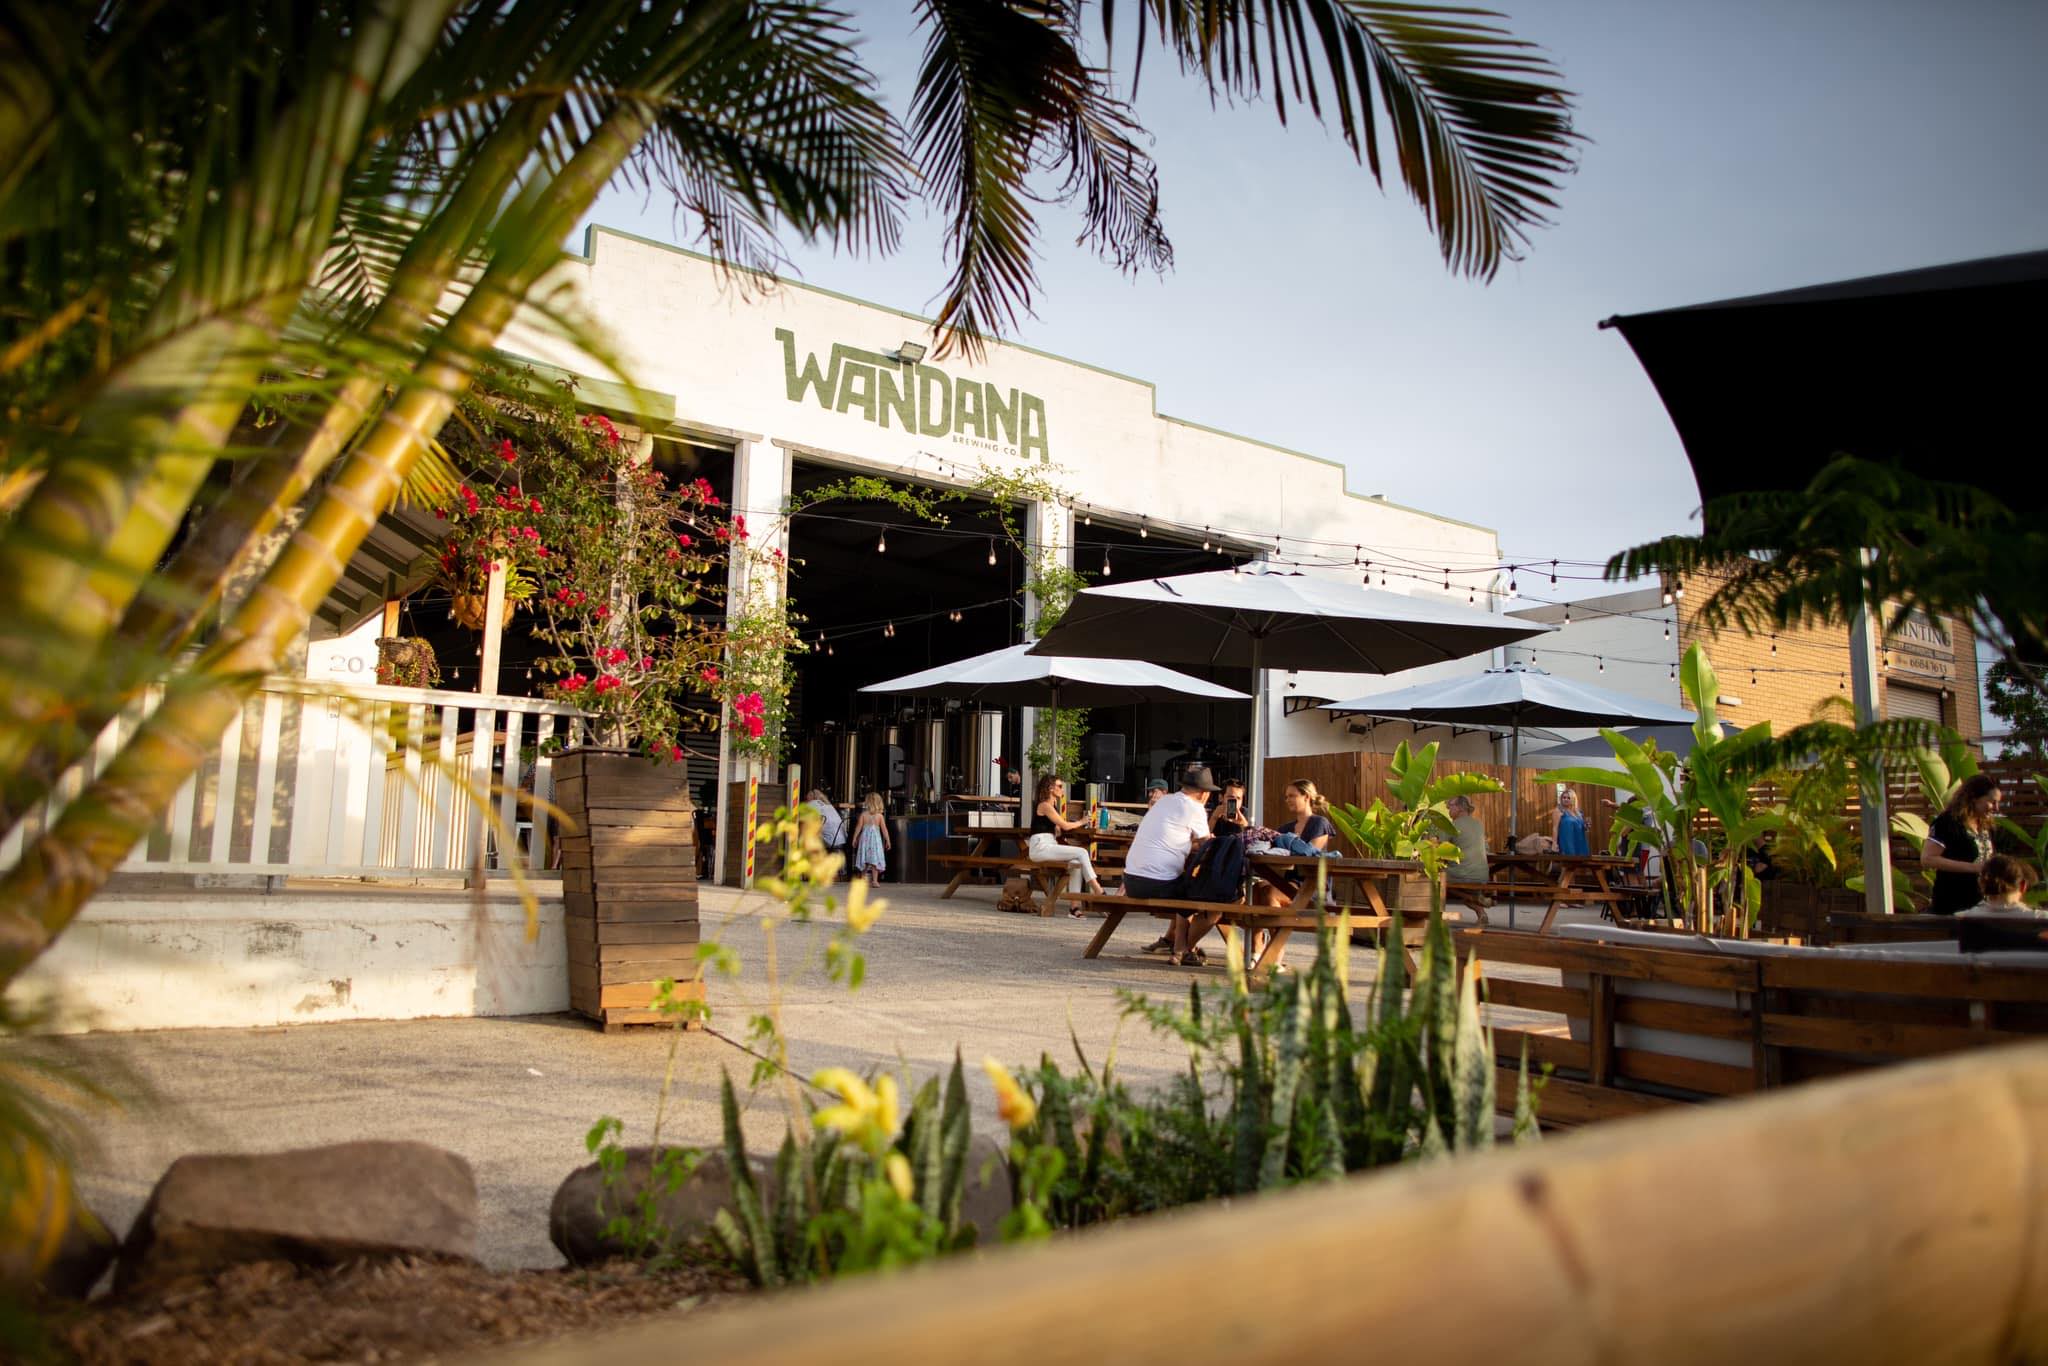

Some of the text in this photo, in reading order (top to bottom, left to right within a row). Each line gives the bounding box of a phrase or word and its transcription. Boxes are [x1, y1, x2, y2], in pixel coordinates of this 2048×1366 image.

[775, 327, 1050, 464] WANDANA
[952, 434, 999, 452] BREWING
[1887, 617, 1951, 647] PINTING
[329, 654, 364, 673] 20
